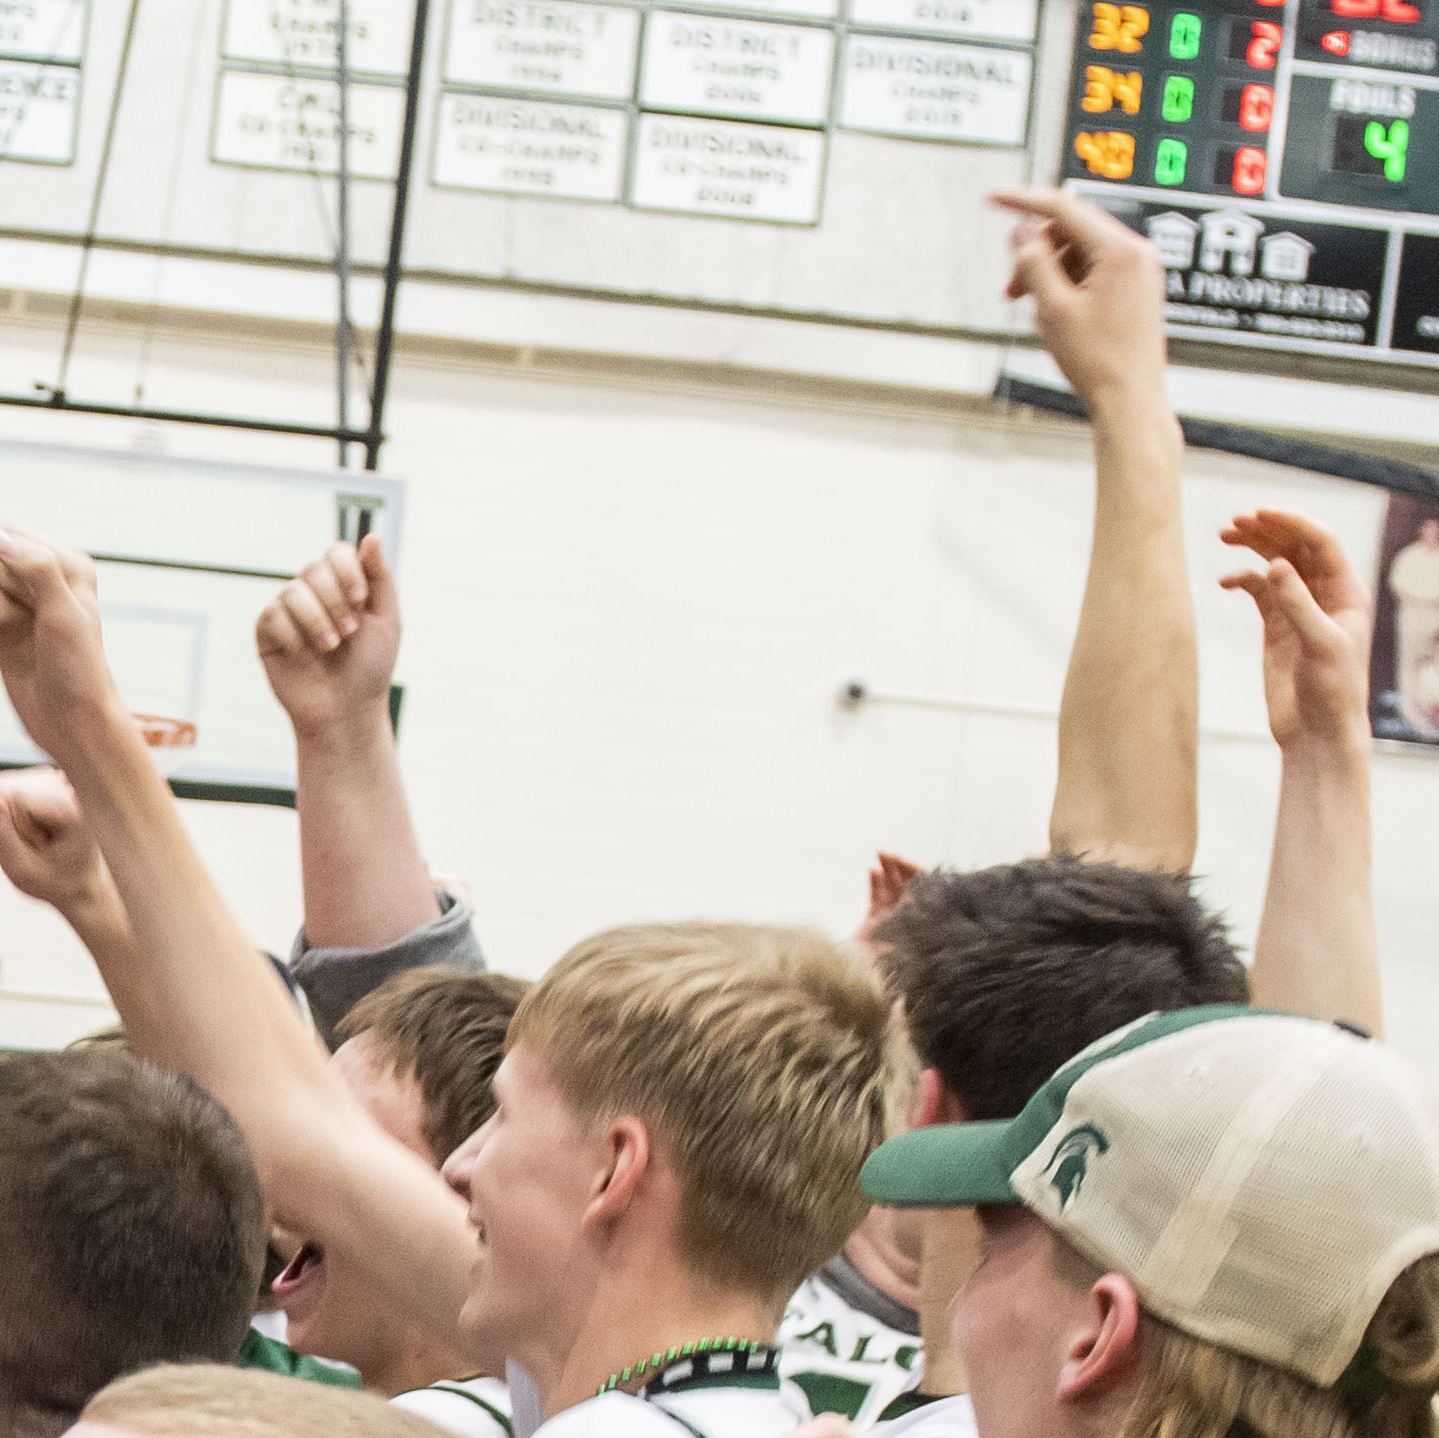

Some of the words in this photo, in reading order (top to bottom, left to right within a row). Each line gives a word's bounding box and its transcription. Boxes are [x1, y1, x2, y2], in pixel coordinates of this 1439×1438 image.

[668, 22, 803, 59] DISTRICT
[1169, 13, 1202, 59] 0
[1246, 20, 1283, 70] 2
[1161, 75, 1195, 123] 0
[1154, 138, 1187, 186] 0
[1364, 119, 1410, 183] 4
